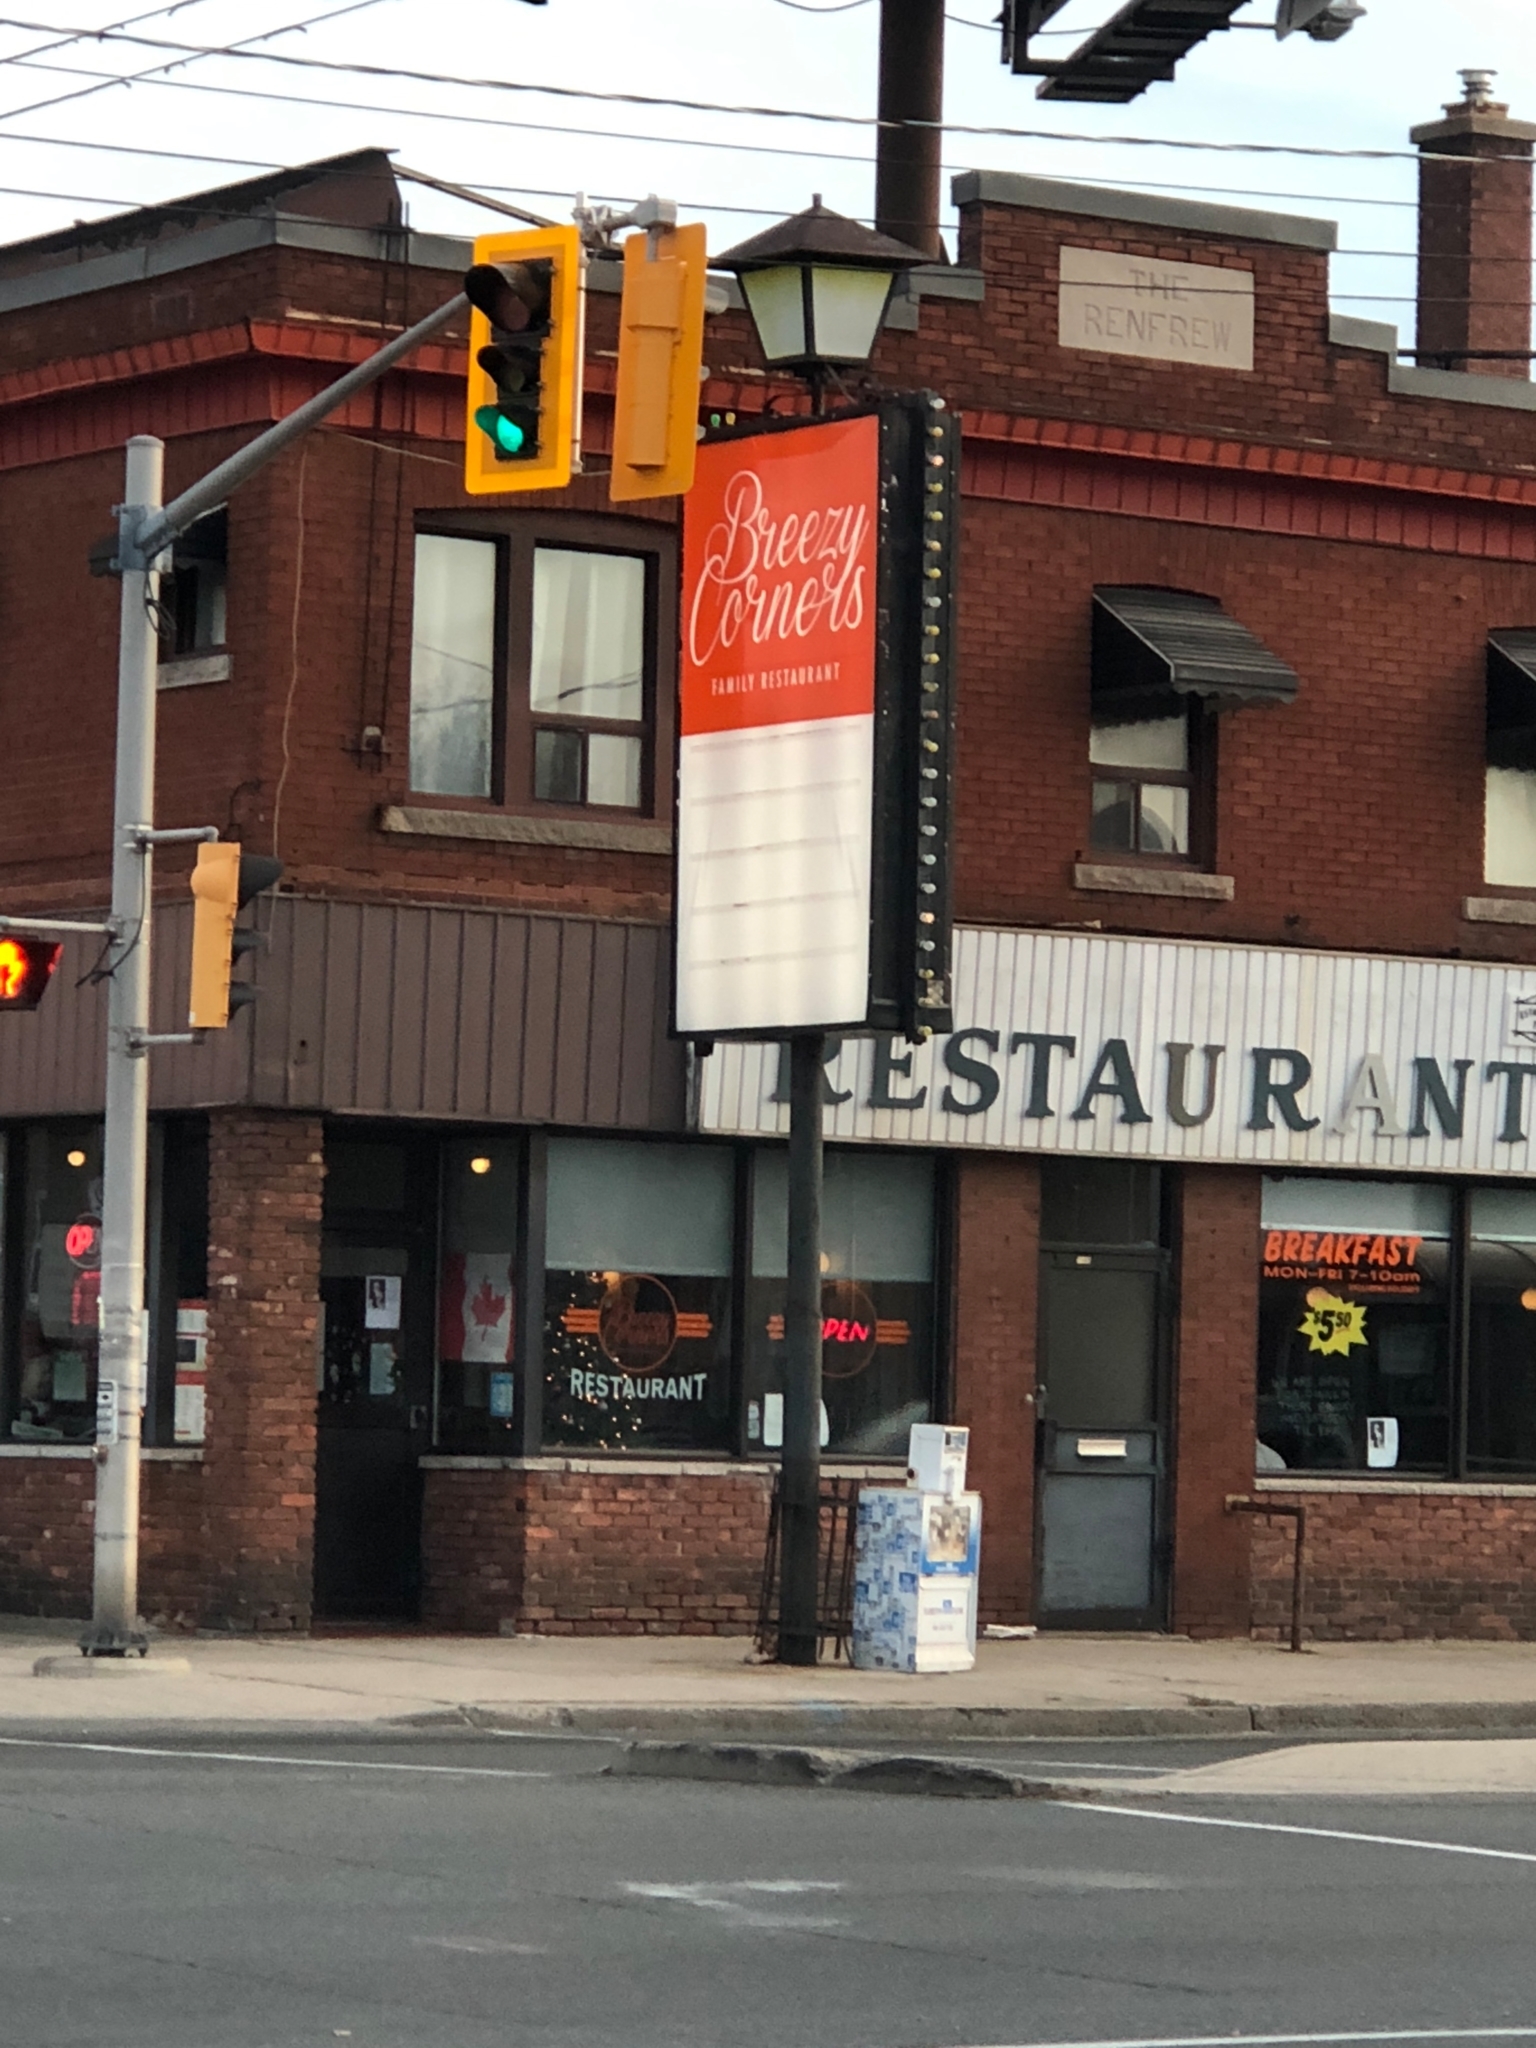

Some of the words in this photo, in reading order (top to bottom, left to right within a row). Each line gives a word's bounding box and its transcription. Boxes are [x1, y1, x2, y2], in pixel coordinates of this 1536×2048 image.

[1129, 269, 1189, 302] THE
[1084, 303, 1232, 352] RENFREW
[705, 470, 870, 606] Breezy
[690, 554, 867, 667] Corners
[711, 672, 755, 696] FAMILY
[760, 661, 841, 691] RESTAURANT
[1264, 1231, 1423, 1266] BREAKFAST
[1263, 1266, 1343, 1280] MON-FRI
[821, 1318, 870, 1342] PEN
[570, 1368, 708, 1400] RESTAURANT
